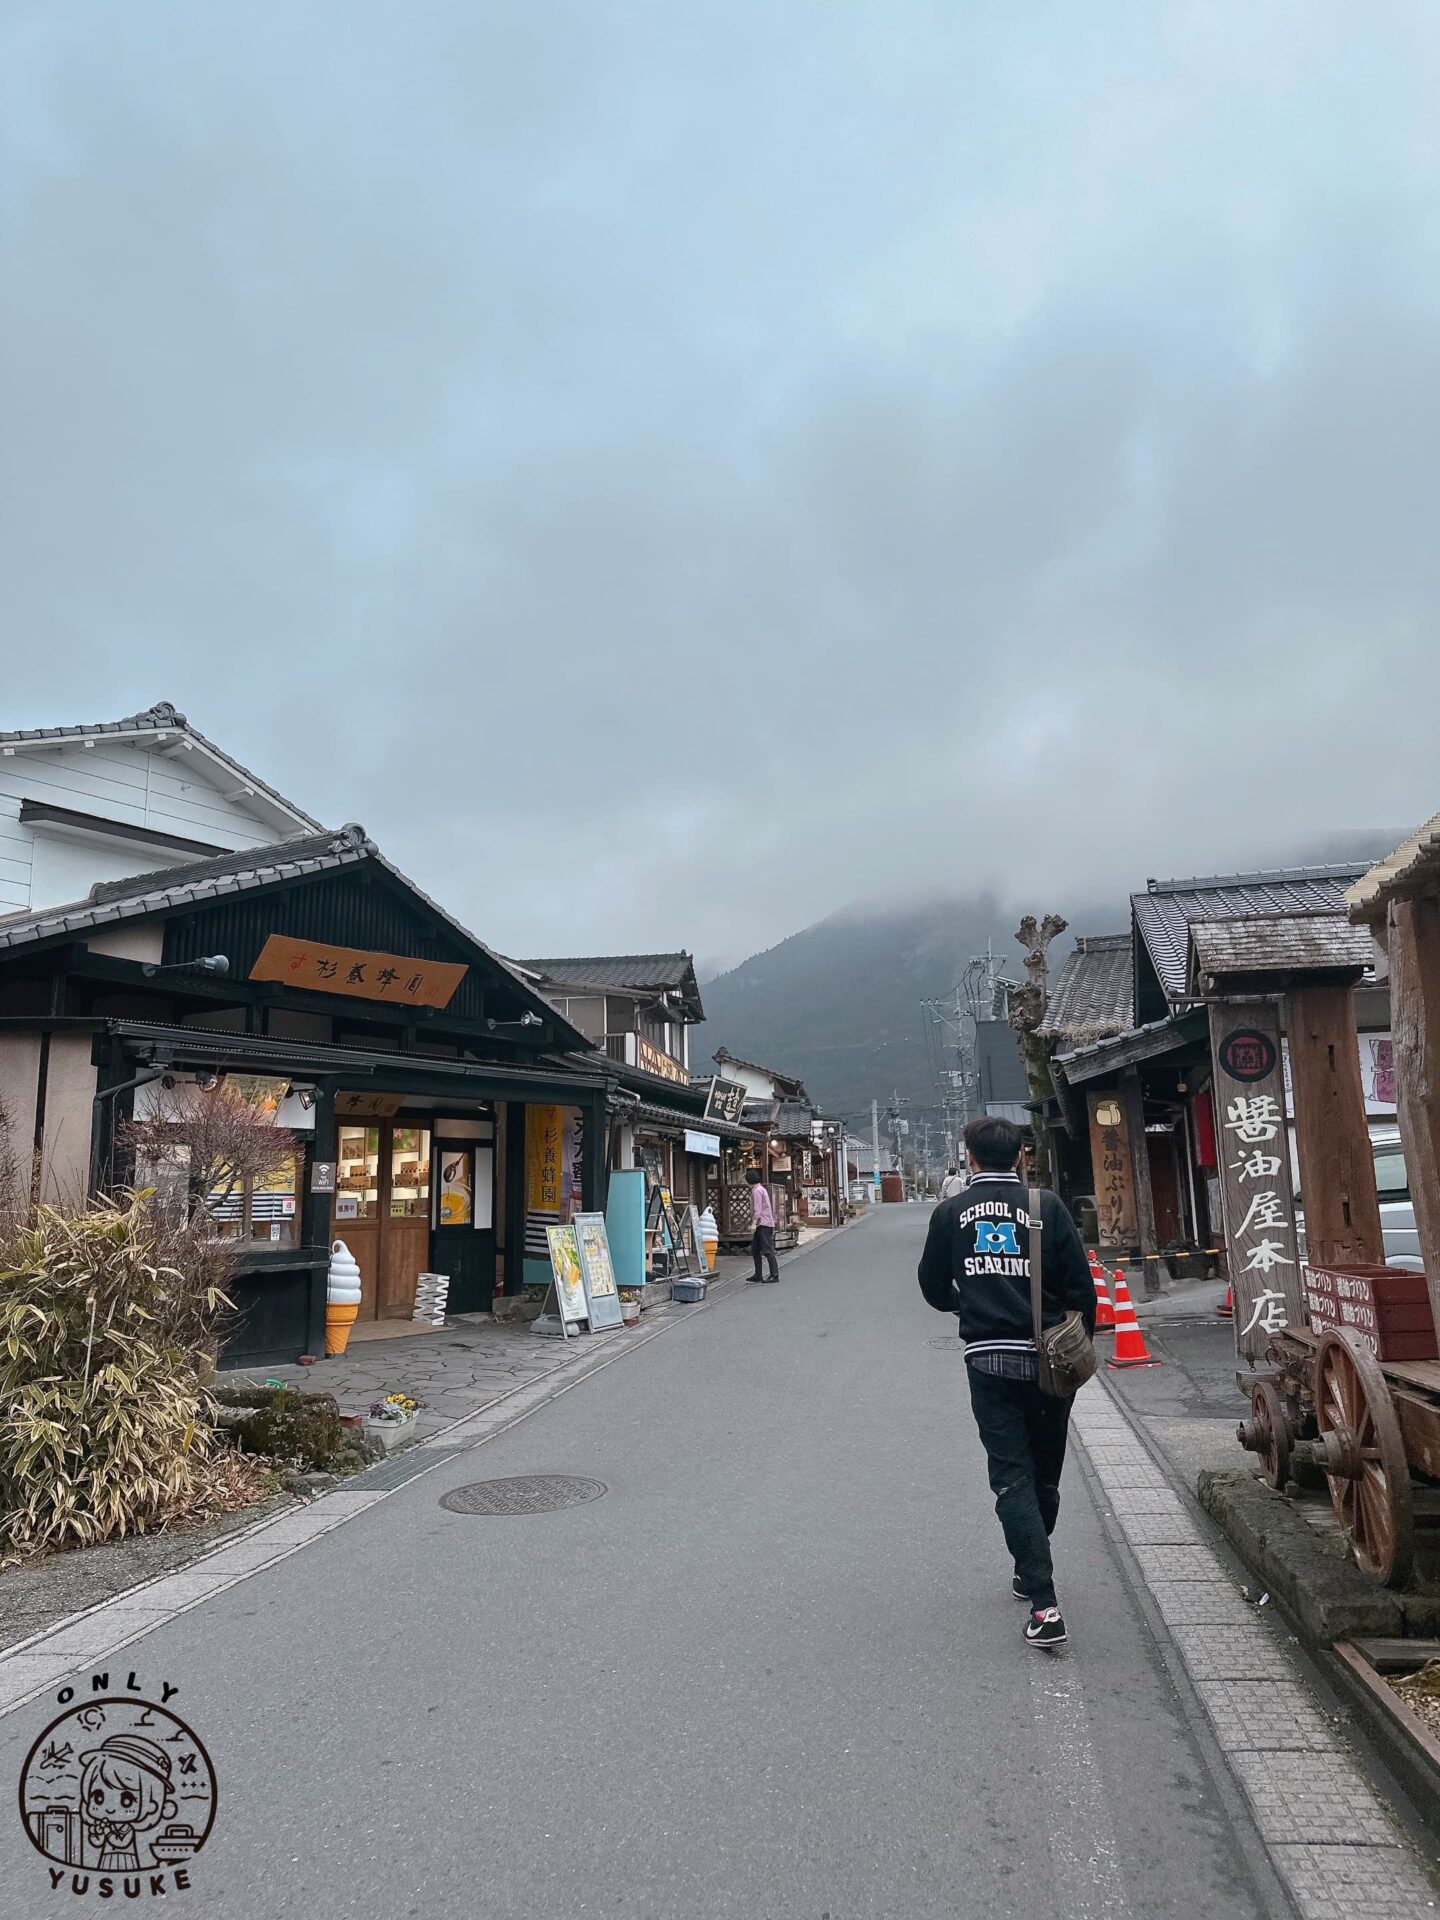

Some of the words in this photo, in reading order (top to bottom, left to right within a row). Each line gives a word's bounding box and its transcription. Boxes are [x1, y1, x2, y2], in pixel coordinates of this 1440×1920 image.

[540, 1126, 559, 1203] 杉養蜂園
[959, 1200, 1012, 1228] SCHOOL
